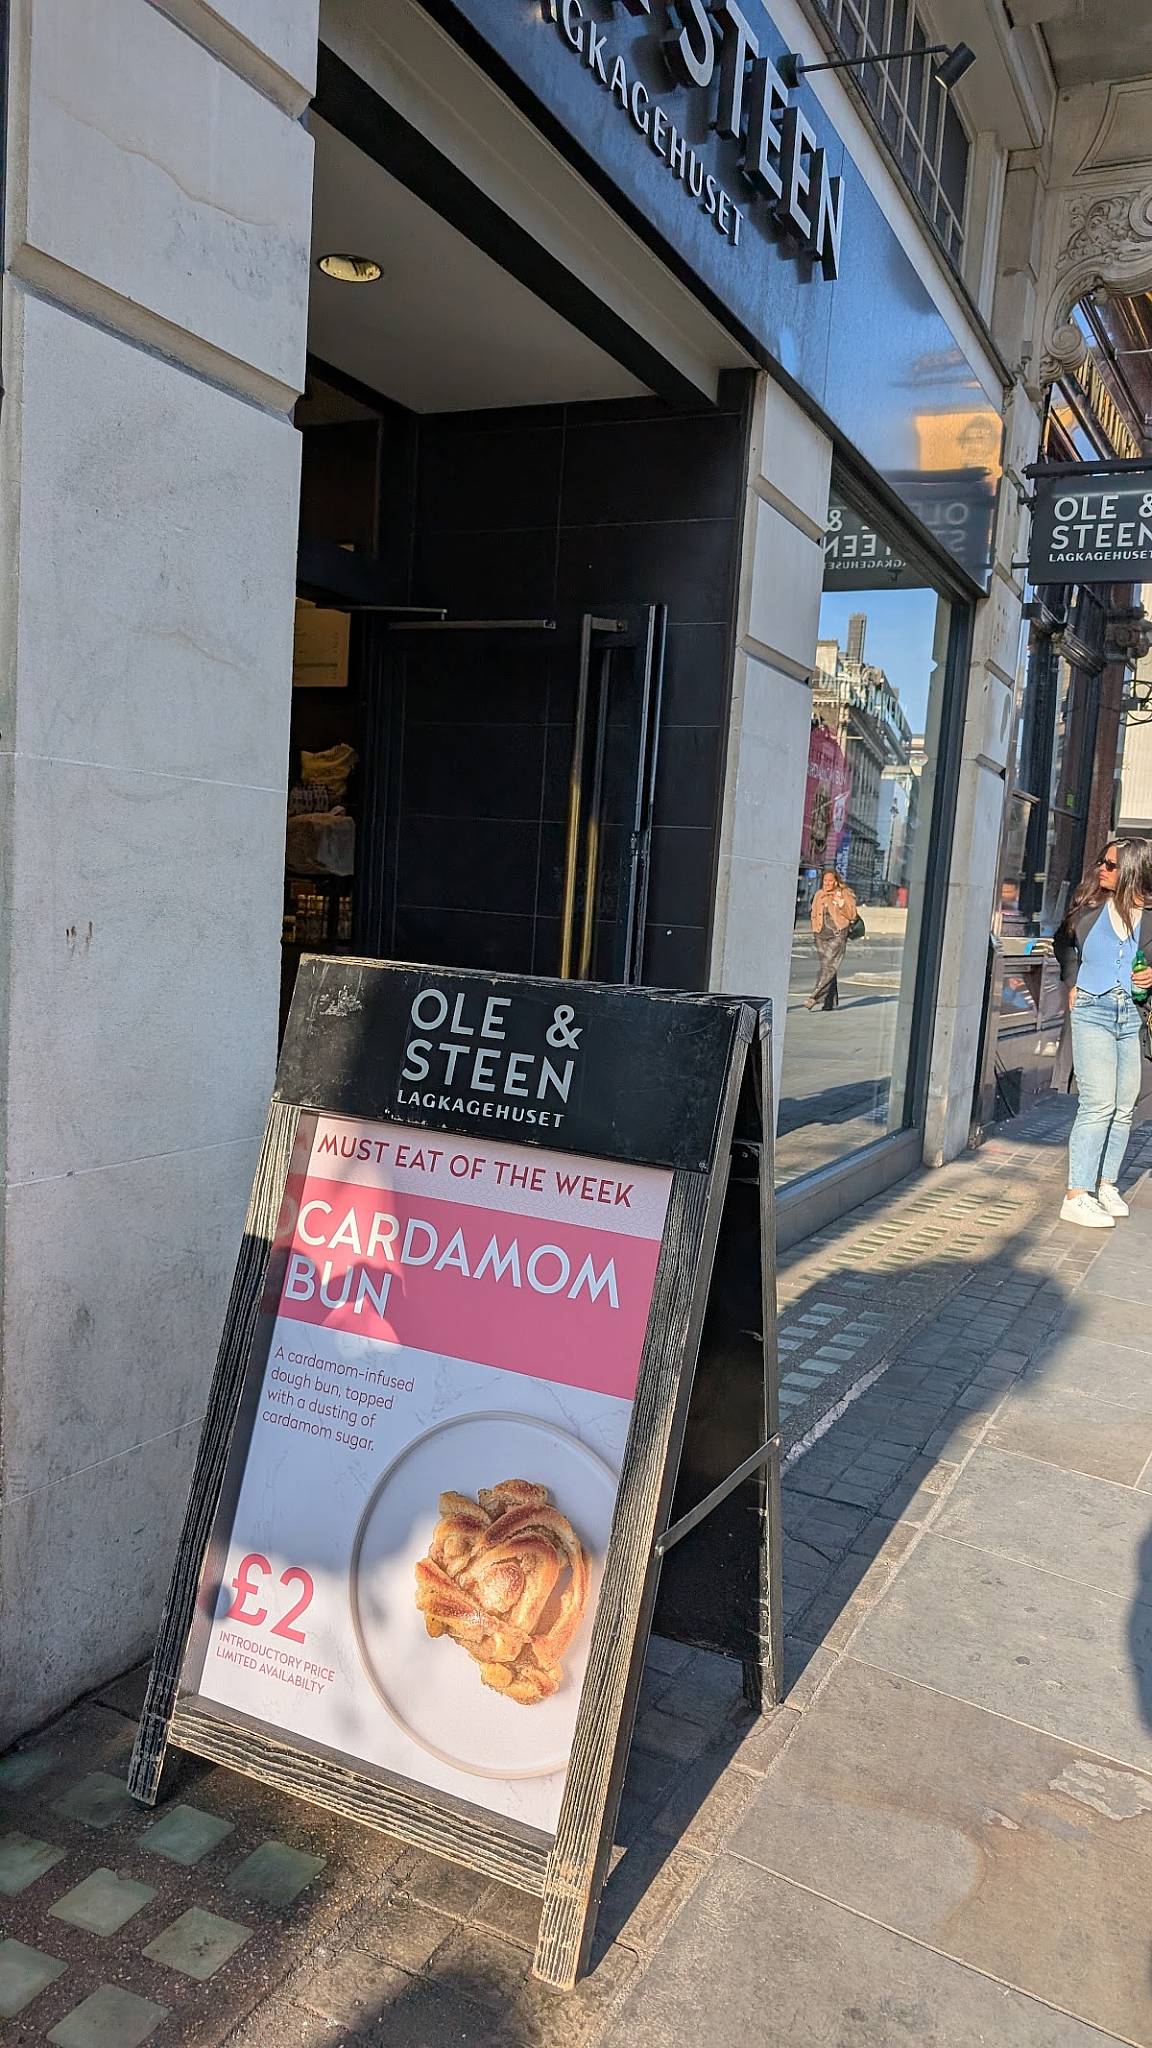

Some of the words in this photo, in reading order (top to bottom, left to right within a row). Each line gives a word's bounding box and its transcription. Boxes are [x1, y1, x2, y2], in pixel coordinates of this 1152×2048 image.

[550, 0, 744, 246] GKAGEHUSET
[1054, 495, 1119, 522] OLE
[1138, 493, 1152, 518] &
[411, 988, 512, 1040] OLE
[546, 1004, 583, 1050] &
[402, 1038, 575, 1104] STEEN
[397, 1089, 565, 1128] LAGKAGEHUSET
[317, 1134, 390, 1164] MUST
[395, 1144, 444, 1174] EAT
[449, 1154, 487, 1180] OF
[494, 1161, 546, 1192] THE
[555, 1171, 635, 1208] WEEK
[297, 1200, 620, 1309] CARDAMOM
[284, 1253, 393, 1320] BUN
[271, 1366, 311, 1391] dough
[314, 1376, 341, 1399] bun,
[345, 1386, 394, 1410] topped
[274, 1345, 285, 1361] A
[287, 1351, 415, 1393] cardamom-infused
[262, 1410, 332, 1439] cardamom
[335, 1430, 374, 1451] sugar.
[267, 1389, 294, 1407] with
[297, 1398, 306, 1409] a
[308, 1398, 358, 1427] dusting
[360, 1413, 377, 1428] of
[225, 1553, 314, 1644] £2
[216, 1646, 258, 1670] LIMITED
[258, 1663, 325, 1695] AVAILABILTY
[219, 1630, 303, 1670] INTRODUCTORY
[303, 1661, 336, 1682] PRICE
